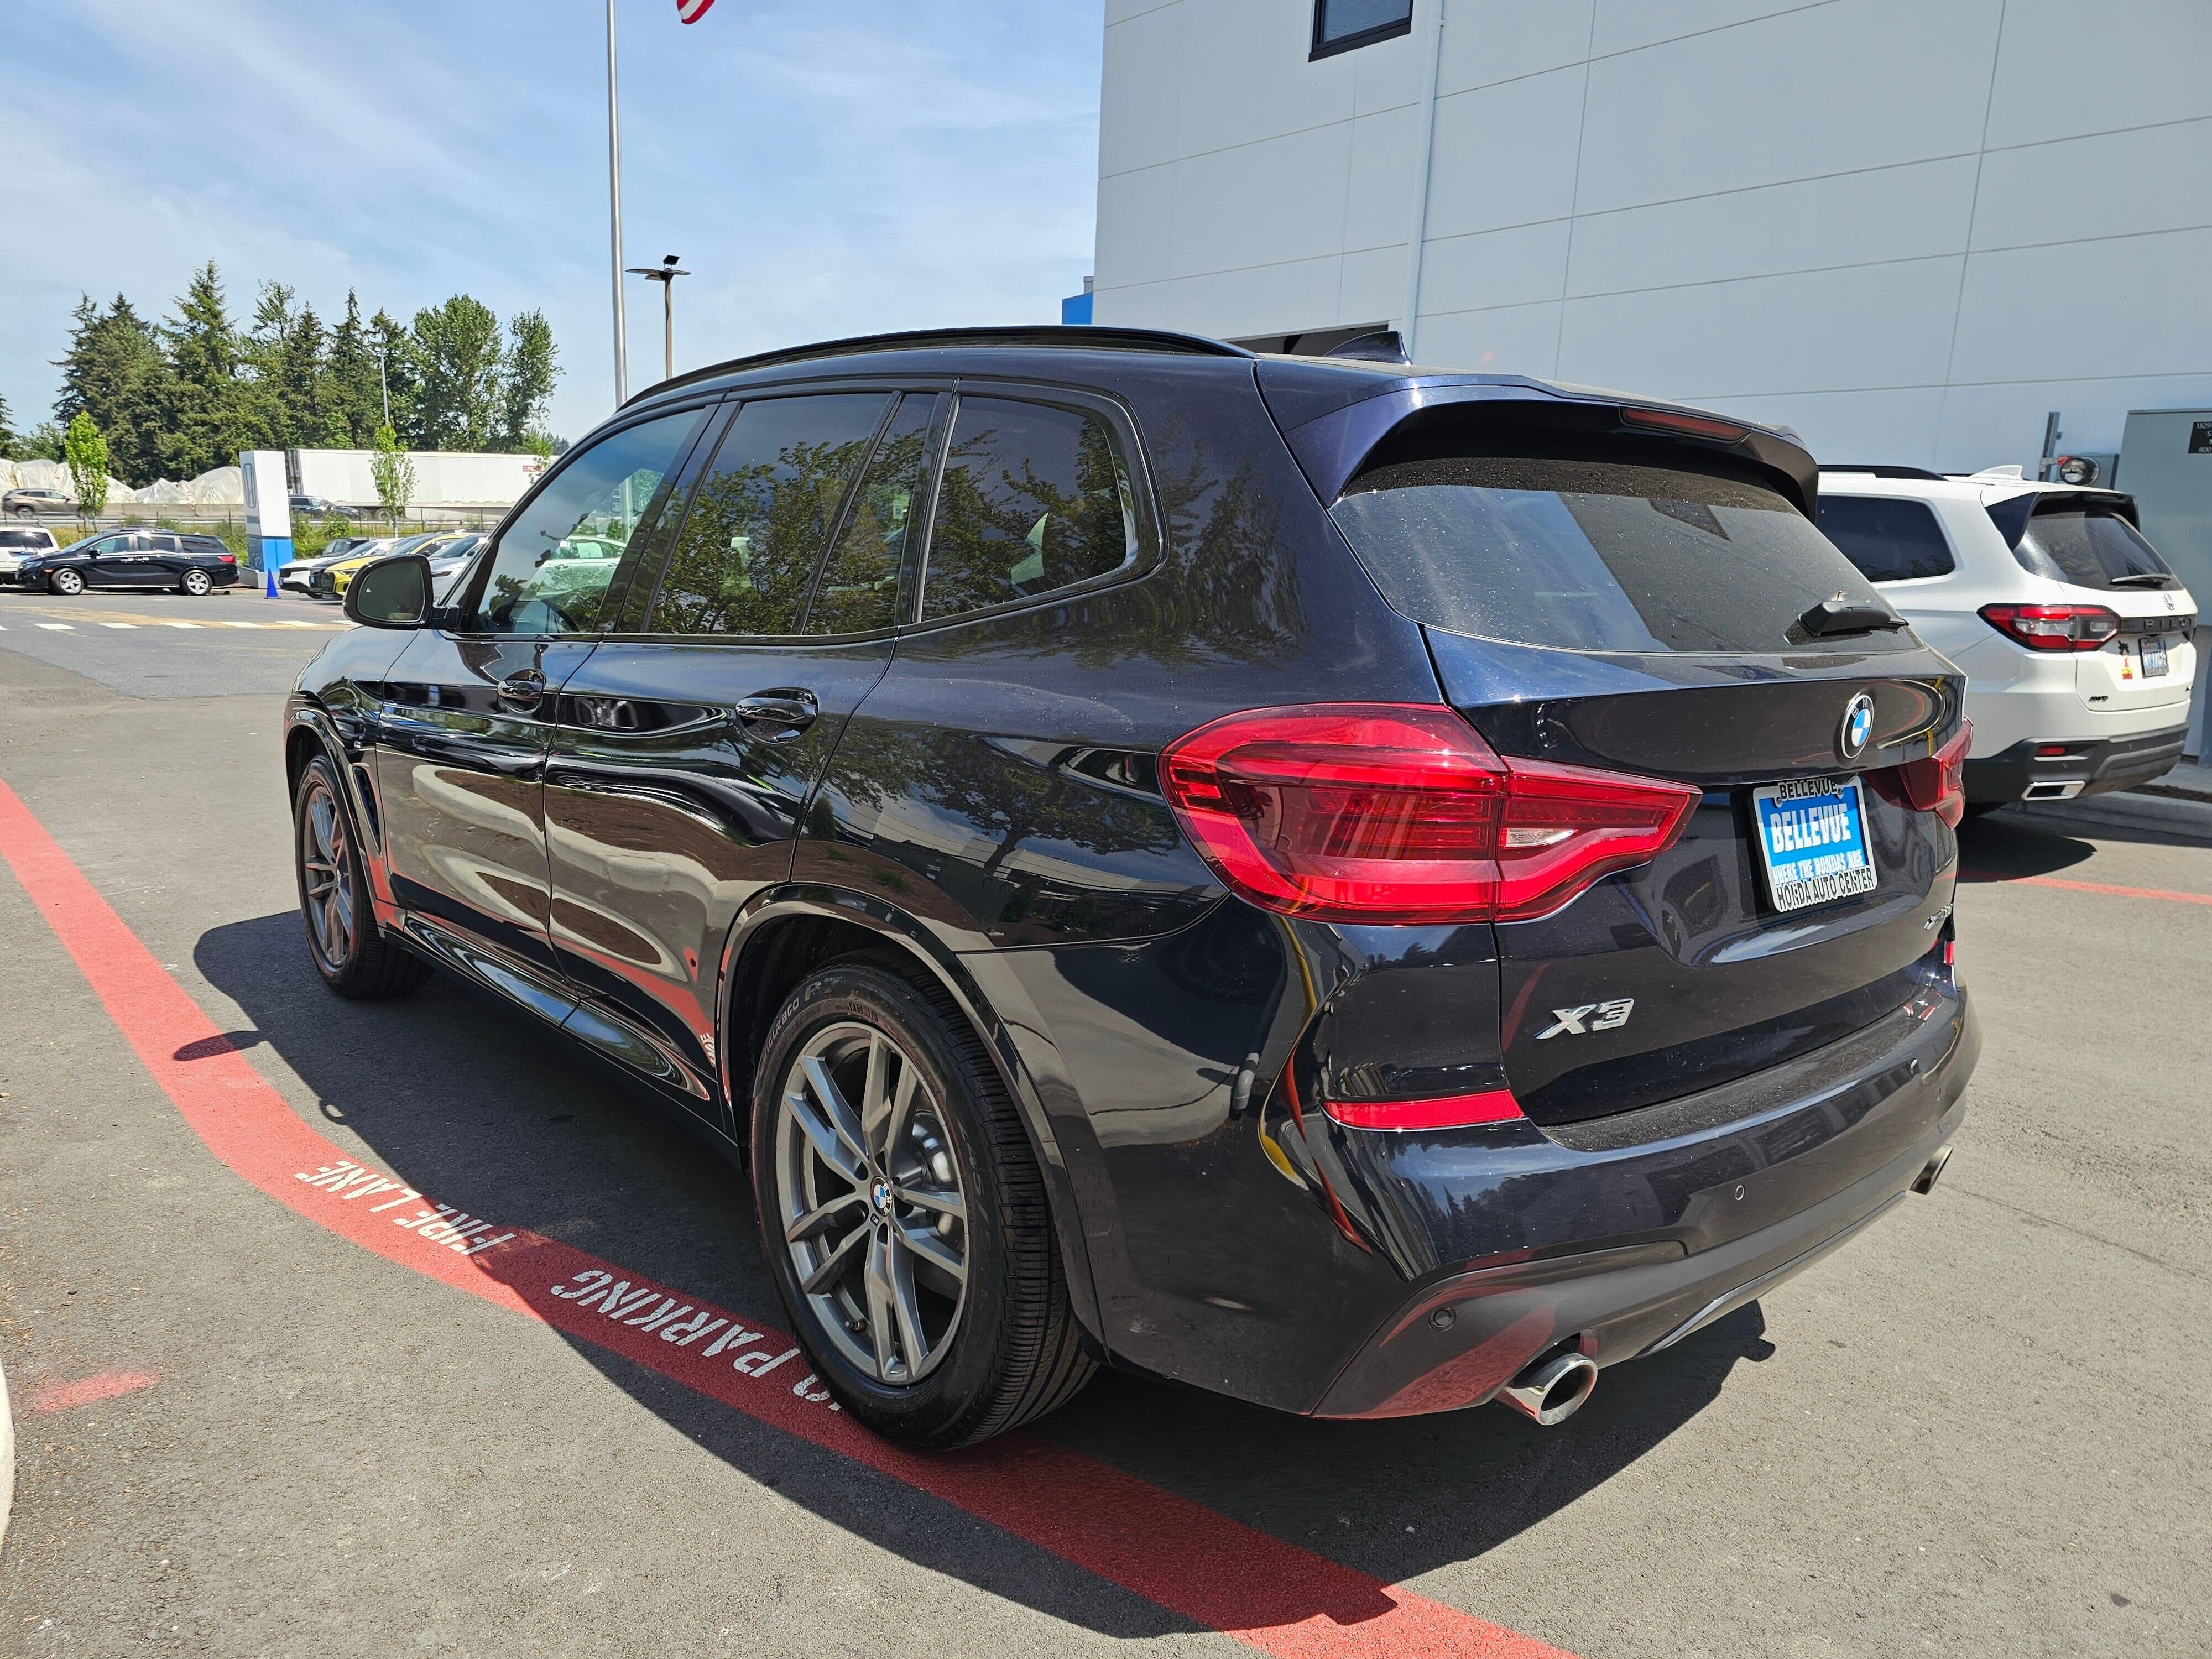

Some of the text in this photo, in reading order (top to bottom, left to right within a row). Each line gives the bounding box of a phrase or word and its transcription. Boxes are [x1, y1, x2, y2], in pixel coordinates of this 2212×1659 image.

[1779, 778, 1837, 800] BELLEVUE
[1770, 802, 1852, 853] BELLEVUE
[1776, 867, 1875, 910] HONDA AUTO CENTER
[1797, 858, 1815, 879] THE
[1535, 998, 1635, 1040] X3
[293, 1160, 517, 1256] FIRE LANE
[550, 1270, 801, 1378] PARKING
